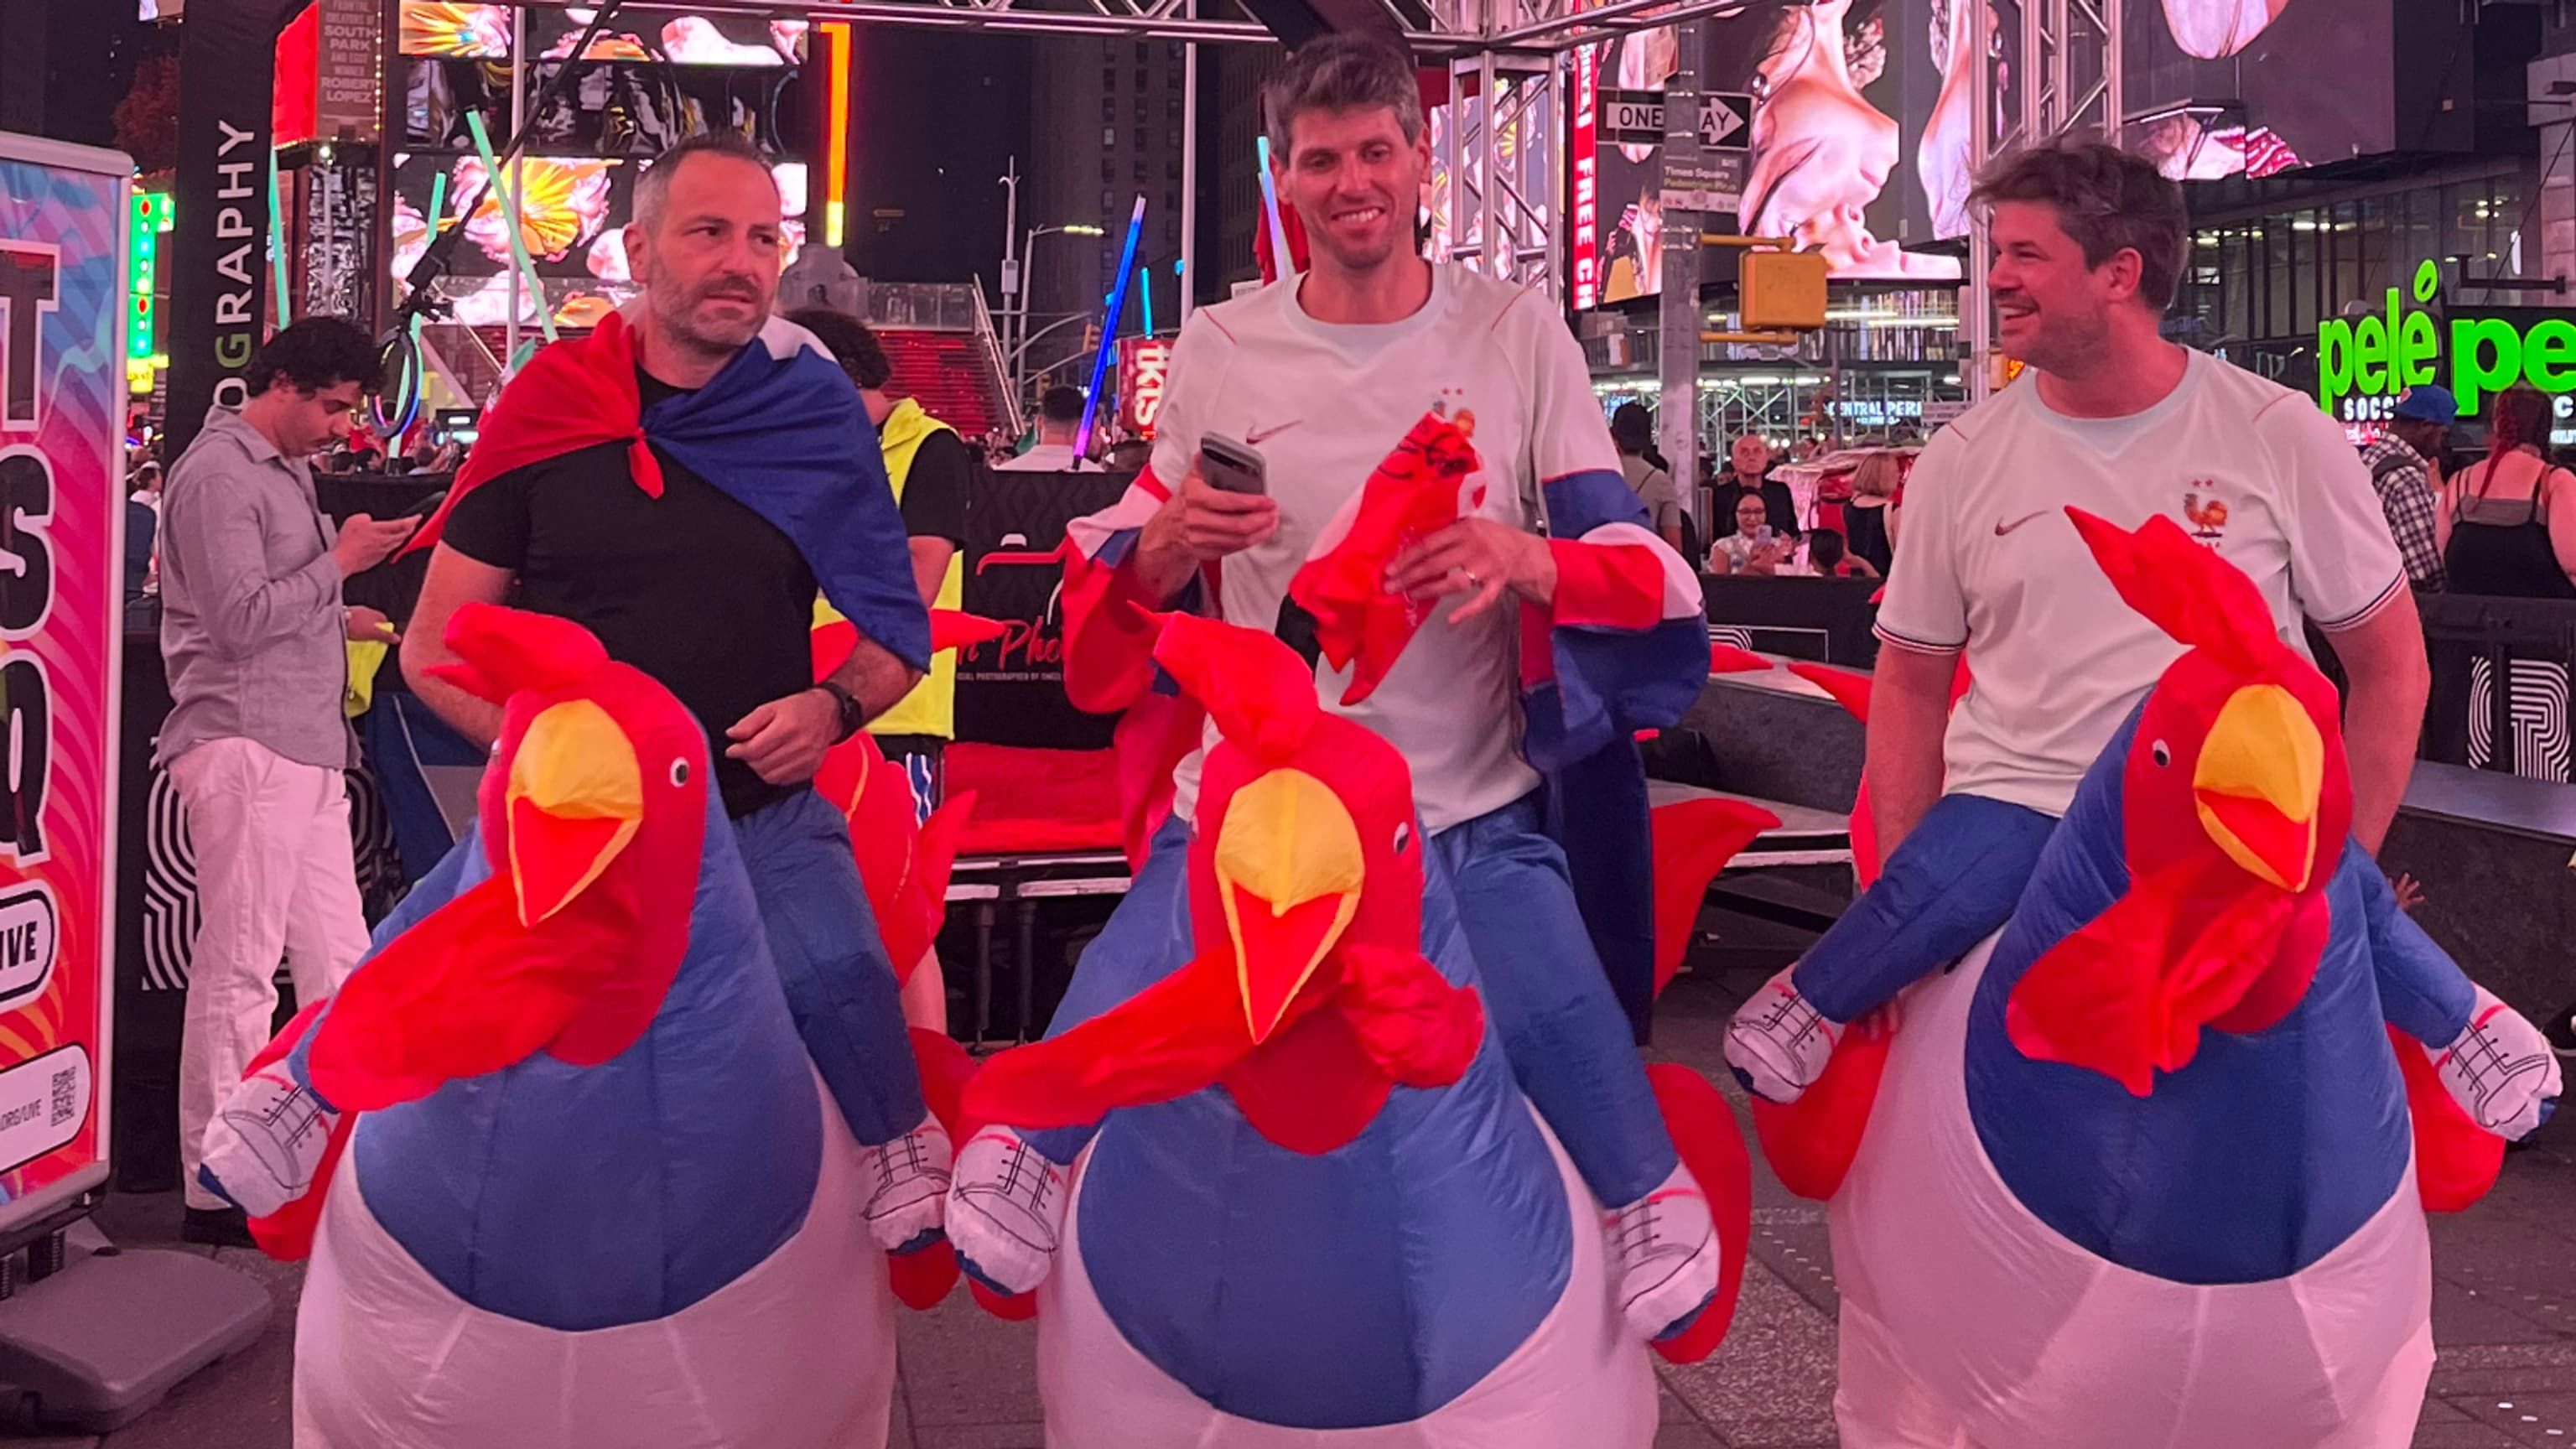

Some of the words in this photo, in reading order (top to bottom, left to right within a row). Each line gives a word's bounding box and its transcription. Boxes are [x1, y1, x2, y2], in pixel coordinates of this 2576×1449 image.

[324, 24, 377, 38] SOUTH
[329, 38, 371, 51] PARK
[321, 76, 377, 90] ROBERT
[325, 90, 372, 103] LOPEZ
[1619, 106, 1664, 127] ONE
[1700, 110, 1730, 131] AY
[1577, 156, 1593, 247] FREE
[2319, 258, 2438, 416] pelé
[2344, 396, 2402, 421] SOCC
